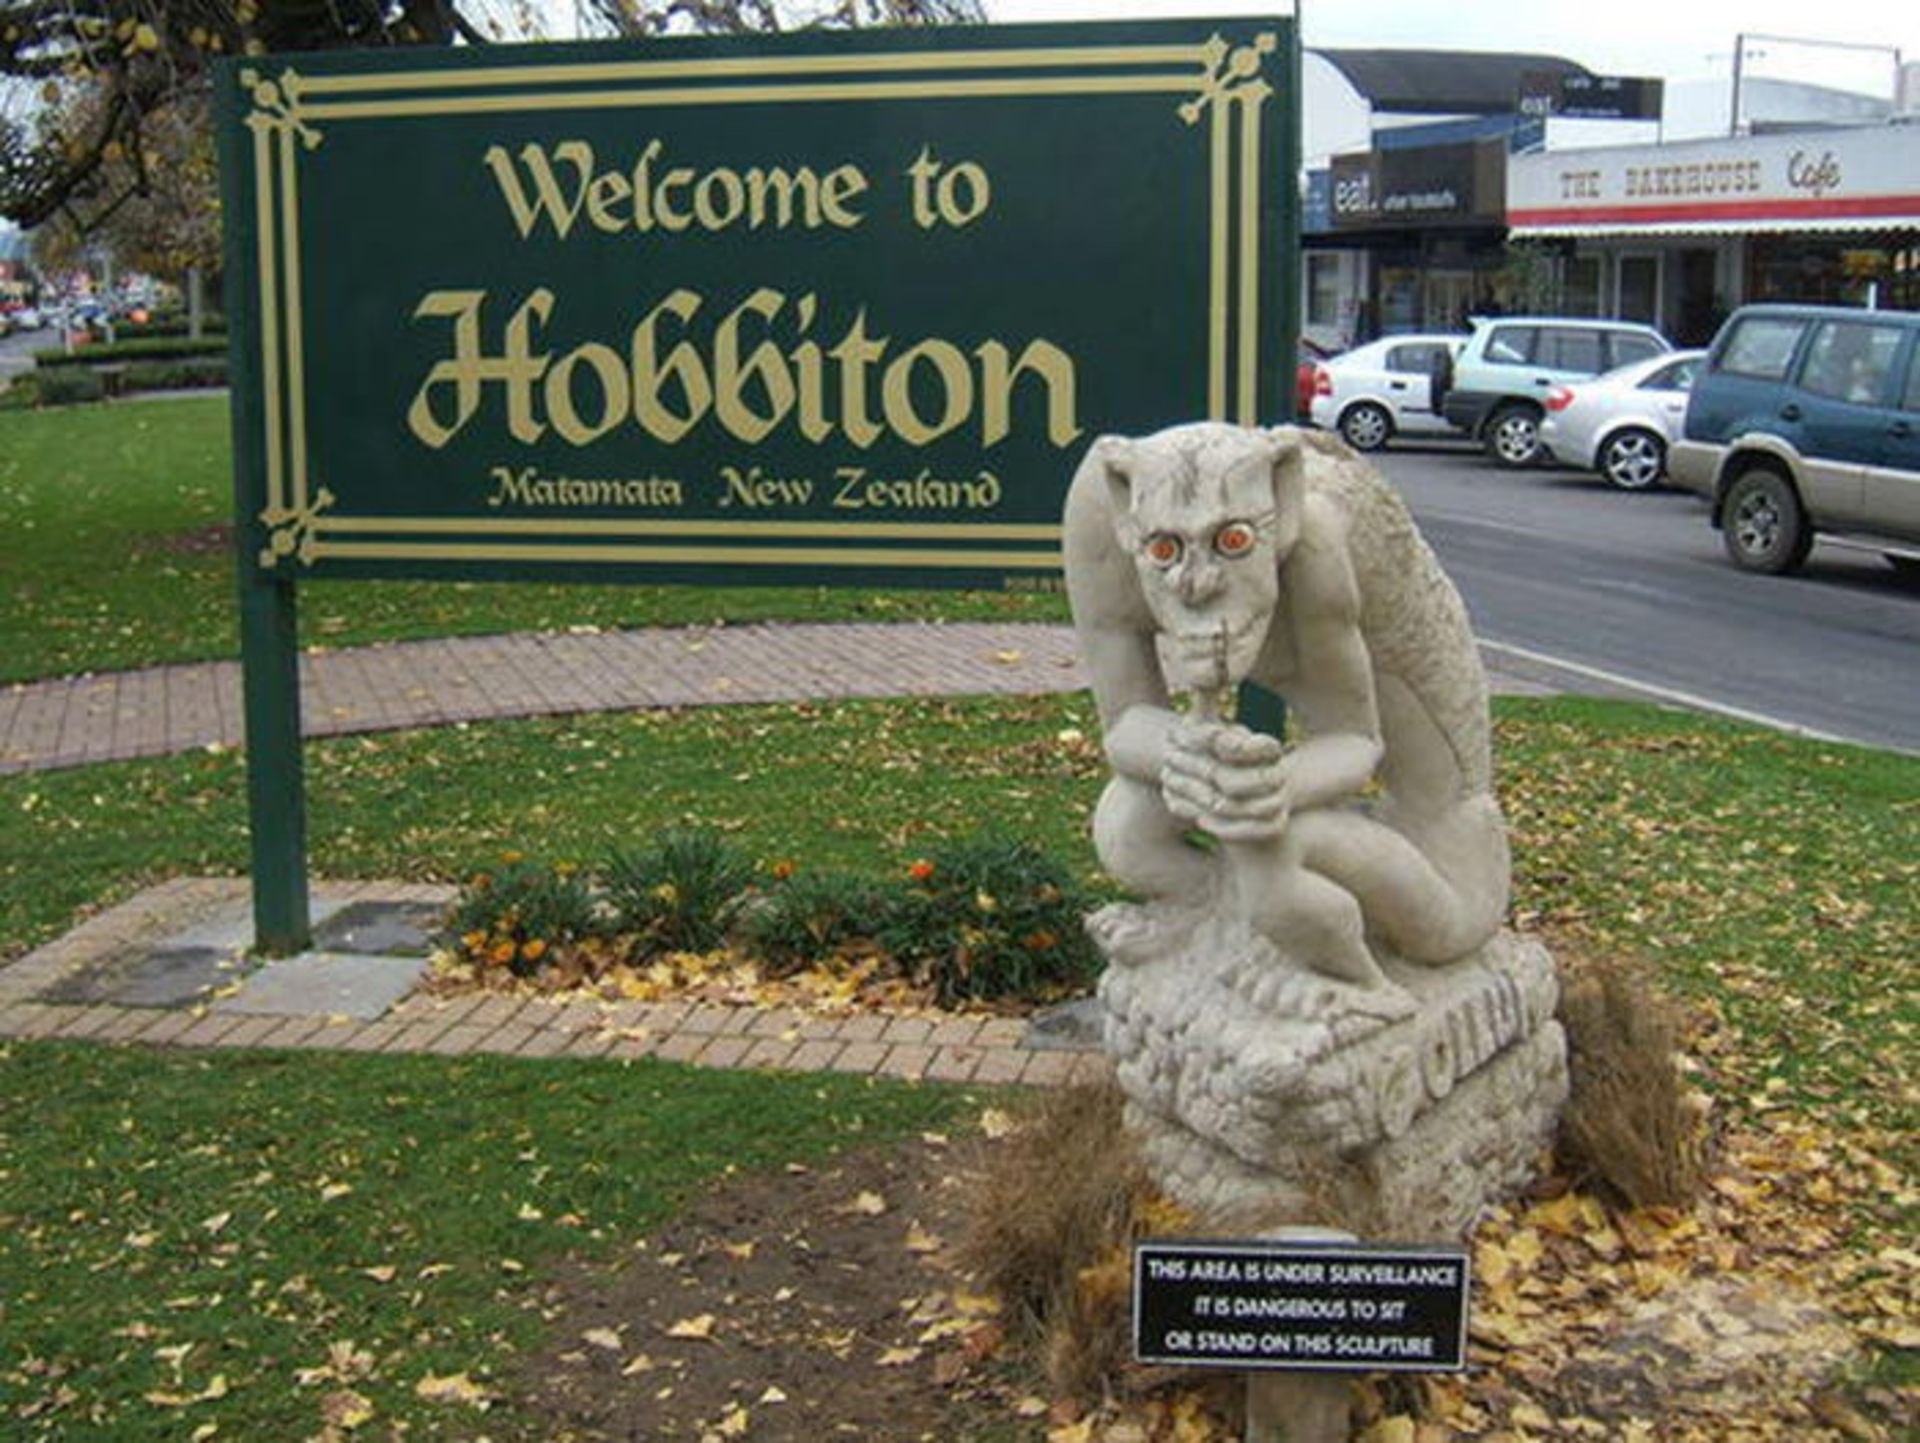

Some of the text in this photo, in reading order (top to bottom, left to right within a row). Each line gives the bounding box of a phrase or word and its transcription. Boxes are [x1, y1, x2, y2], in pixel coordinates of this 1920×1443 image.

[485, 139, 989, 239] Welcome to
[1561, 170, 1600, 198] THE
[408, 288, 1083, 449] Hobbiton
[488, 466, 1001, 509] Matamata New Zealand
[1147, 1259, 1187, 1281] THIS
[1189, 1260, 1241, 1281] AREA
[1244, 1262, 1261, 1282] IS
[1264, 1263, 1325, 1285] UNDER
[1194, 1296, 1406, 1320] IT IS DANGEROUS TO SIT
[1164, 1330, 1434, 1358] OR STAND ON THIS SCULPTURE
